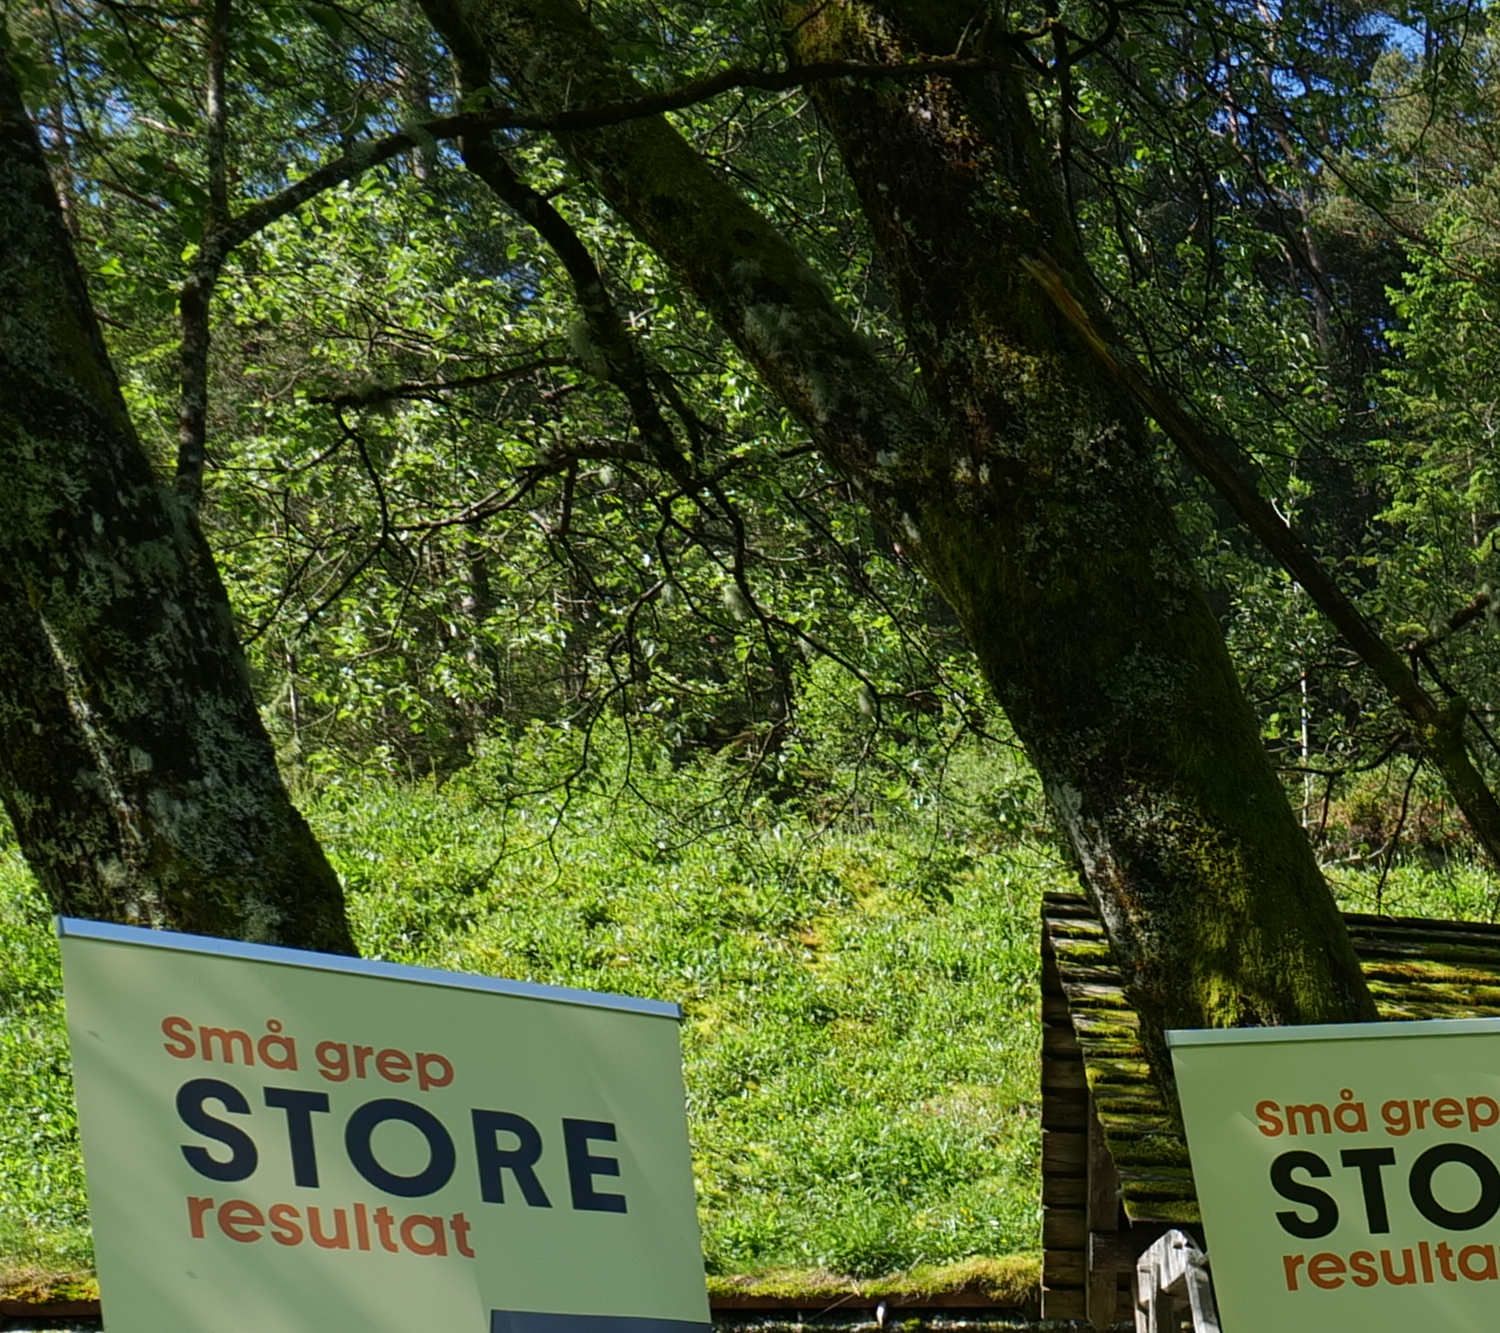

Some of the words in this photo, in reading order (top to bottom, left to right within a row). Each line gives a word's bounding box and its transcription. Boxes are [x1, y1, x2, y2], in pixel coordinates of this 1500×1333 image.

[314, 1040, 455, 1093] grep
[1381, 1094, 1500, 1137] grep
[175, 1077, 628, 1214] STORE
[187, 1195, 475, 1259] resultat
